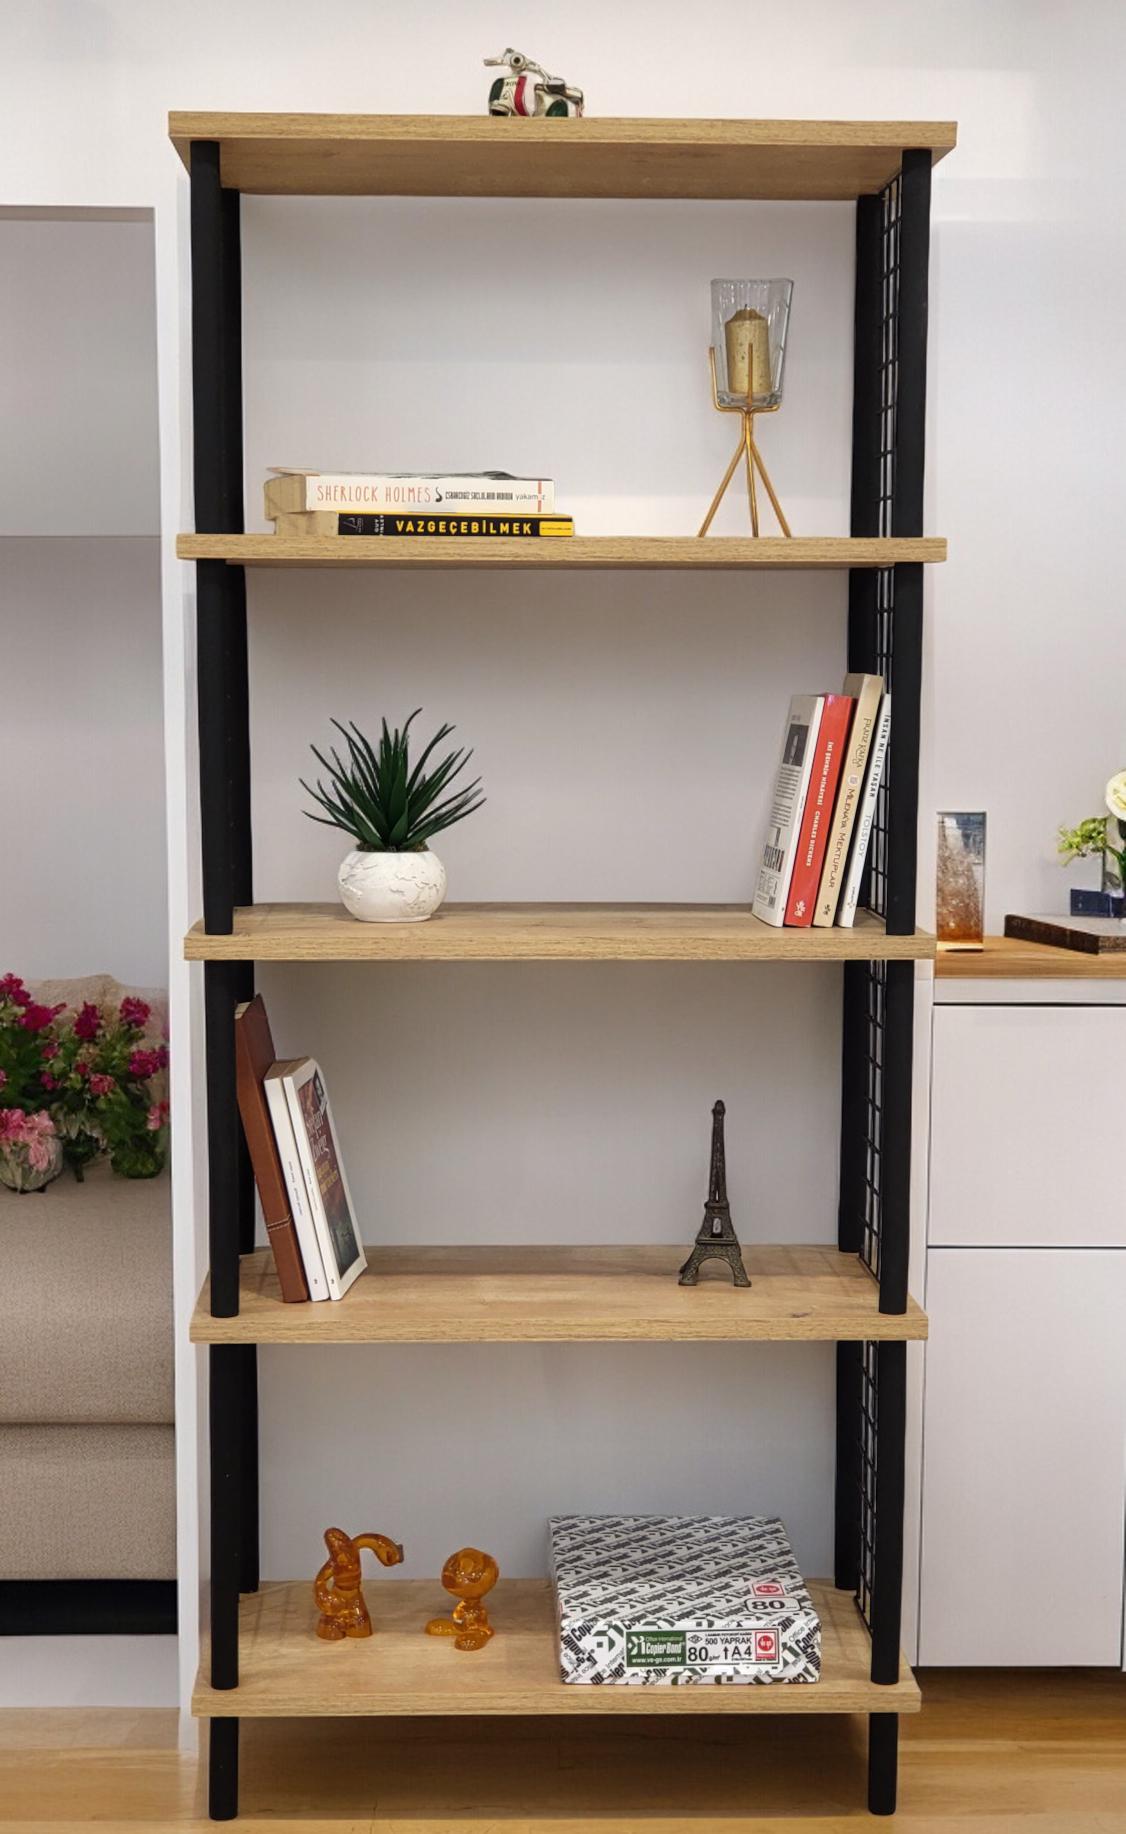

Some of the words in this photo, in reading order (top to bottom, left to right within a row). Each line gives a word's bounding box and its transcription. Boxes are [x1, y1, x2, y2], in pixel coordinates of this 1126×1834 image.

[316, 485, 378, 502] SHERLOCK
[385, 485, 432, 503] HOLMES
[396, 520, 531, 535] VAZGEÇEBİLMEK
[811, 810, 820, 838] CHARLES
[858, 815, 872, 857] TOLSTOY
[806, 839, 816, 867] DICKENS
[828, 832, 847, 888] MEKTUPLAR
[751, 1599, 786, 1610] 80
[720, 1637, 752, 1645] YAPRAK
[687, 1646, 709, 1662] 80
